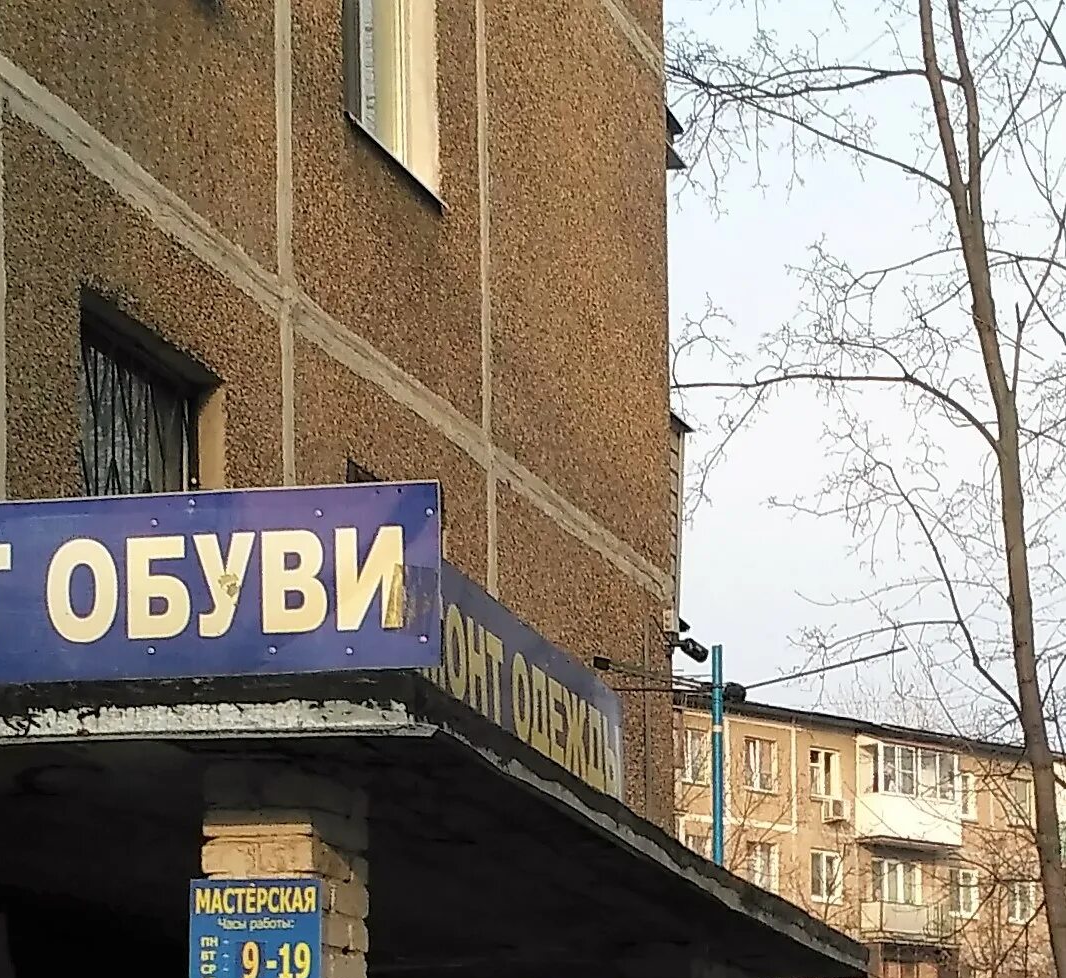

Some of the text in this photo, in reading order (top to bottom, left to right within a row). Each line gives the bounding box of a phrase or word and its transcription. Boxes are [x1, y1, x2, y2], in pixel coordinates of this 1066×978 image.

[46, 525, 405, 644] ОБУВИ
[424, 604, 504, 728] ОНТ
[195, 886, 316, 914] МАСТЕРСКАЯ
[217, 917, 294, 931] Часы работы:
